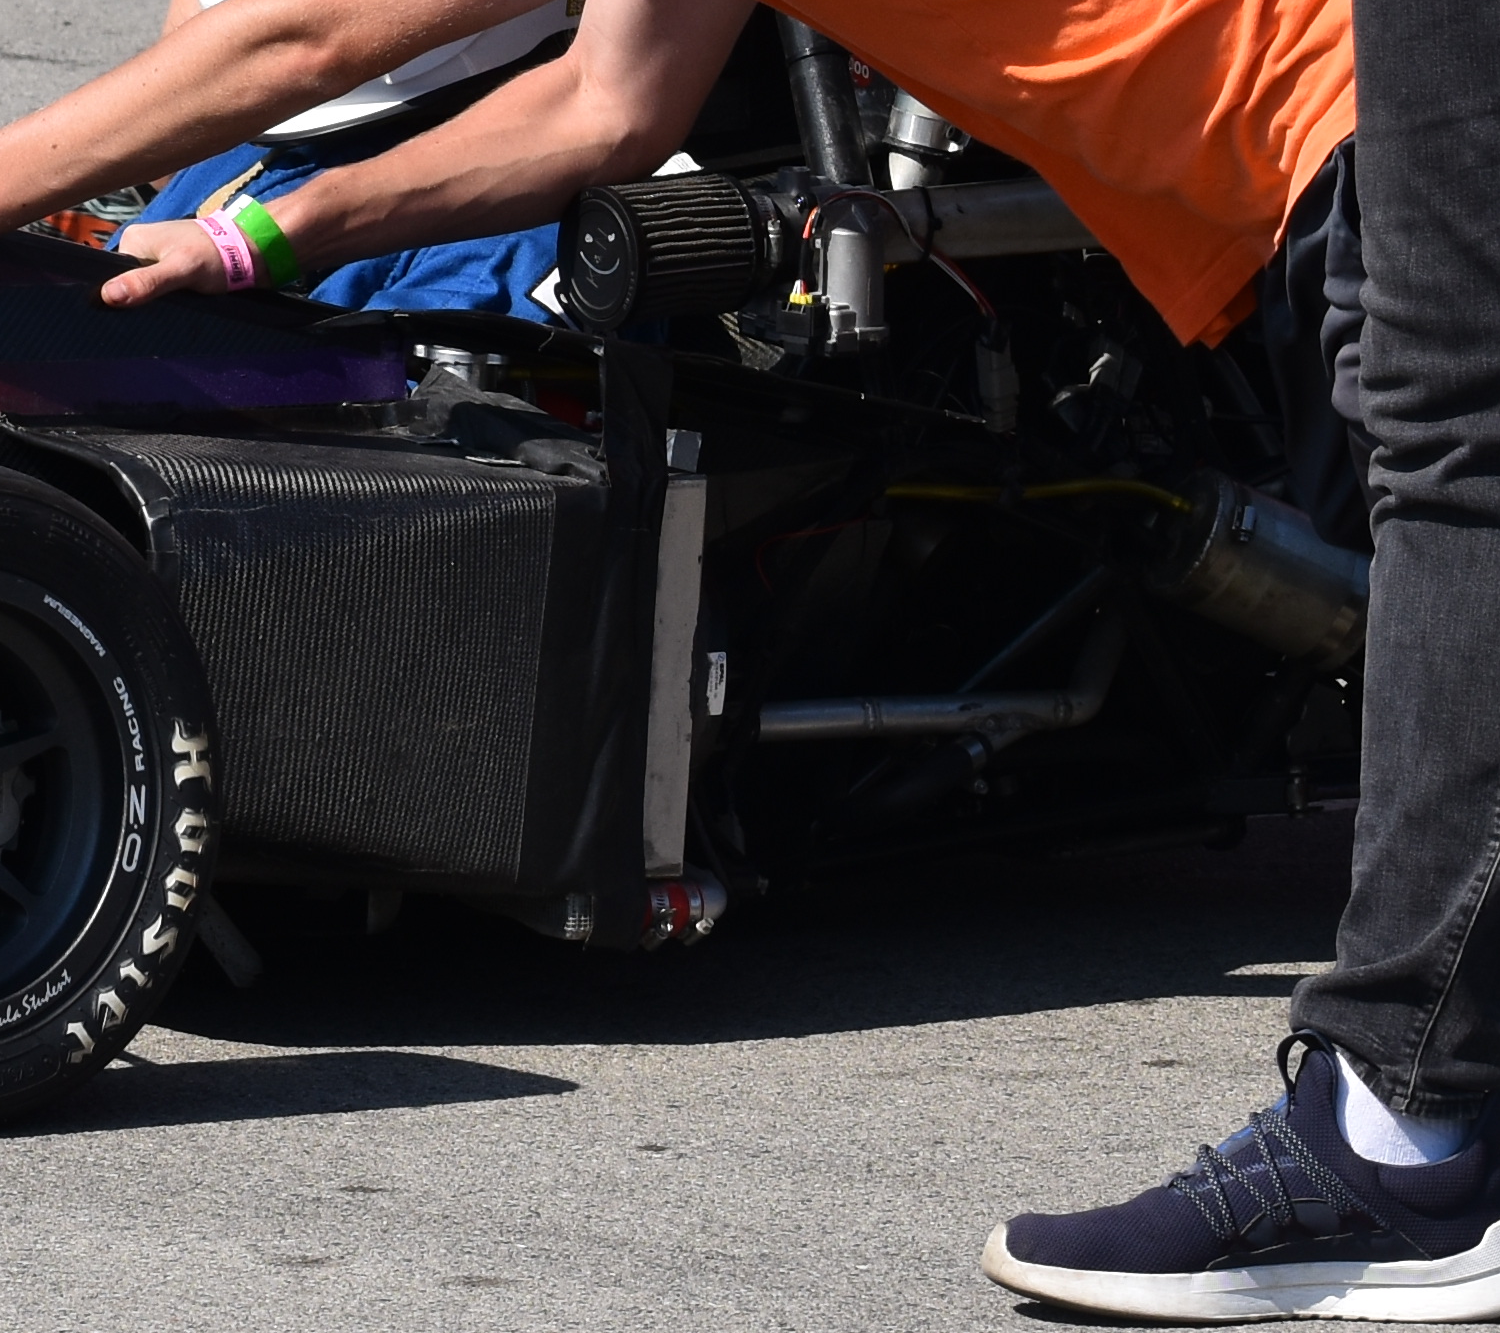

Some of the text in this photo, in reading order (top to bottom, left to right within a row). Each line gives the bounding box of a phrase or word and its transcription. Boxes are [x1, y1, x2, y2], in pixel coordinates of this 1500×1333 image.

[41, 592, 107, 659] MAGNESIUM
[112, 675, 147, 773] RACING
[18, 970, 72, 1019] Student
